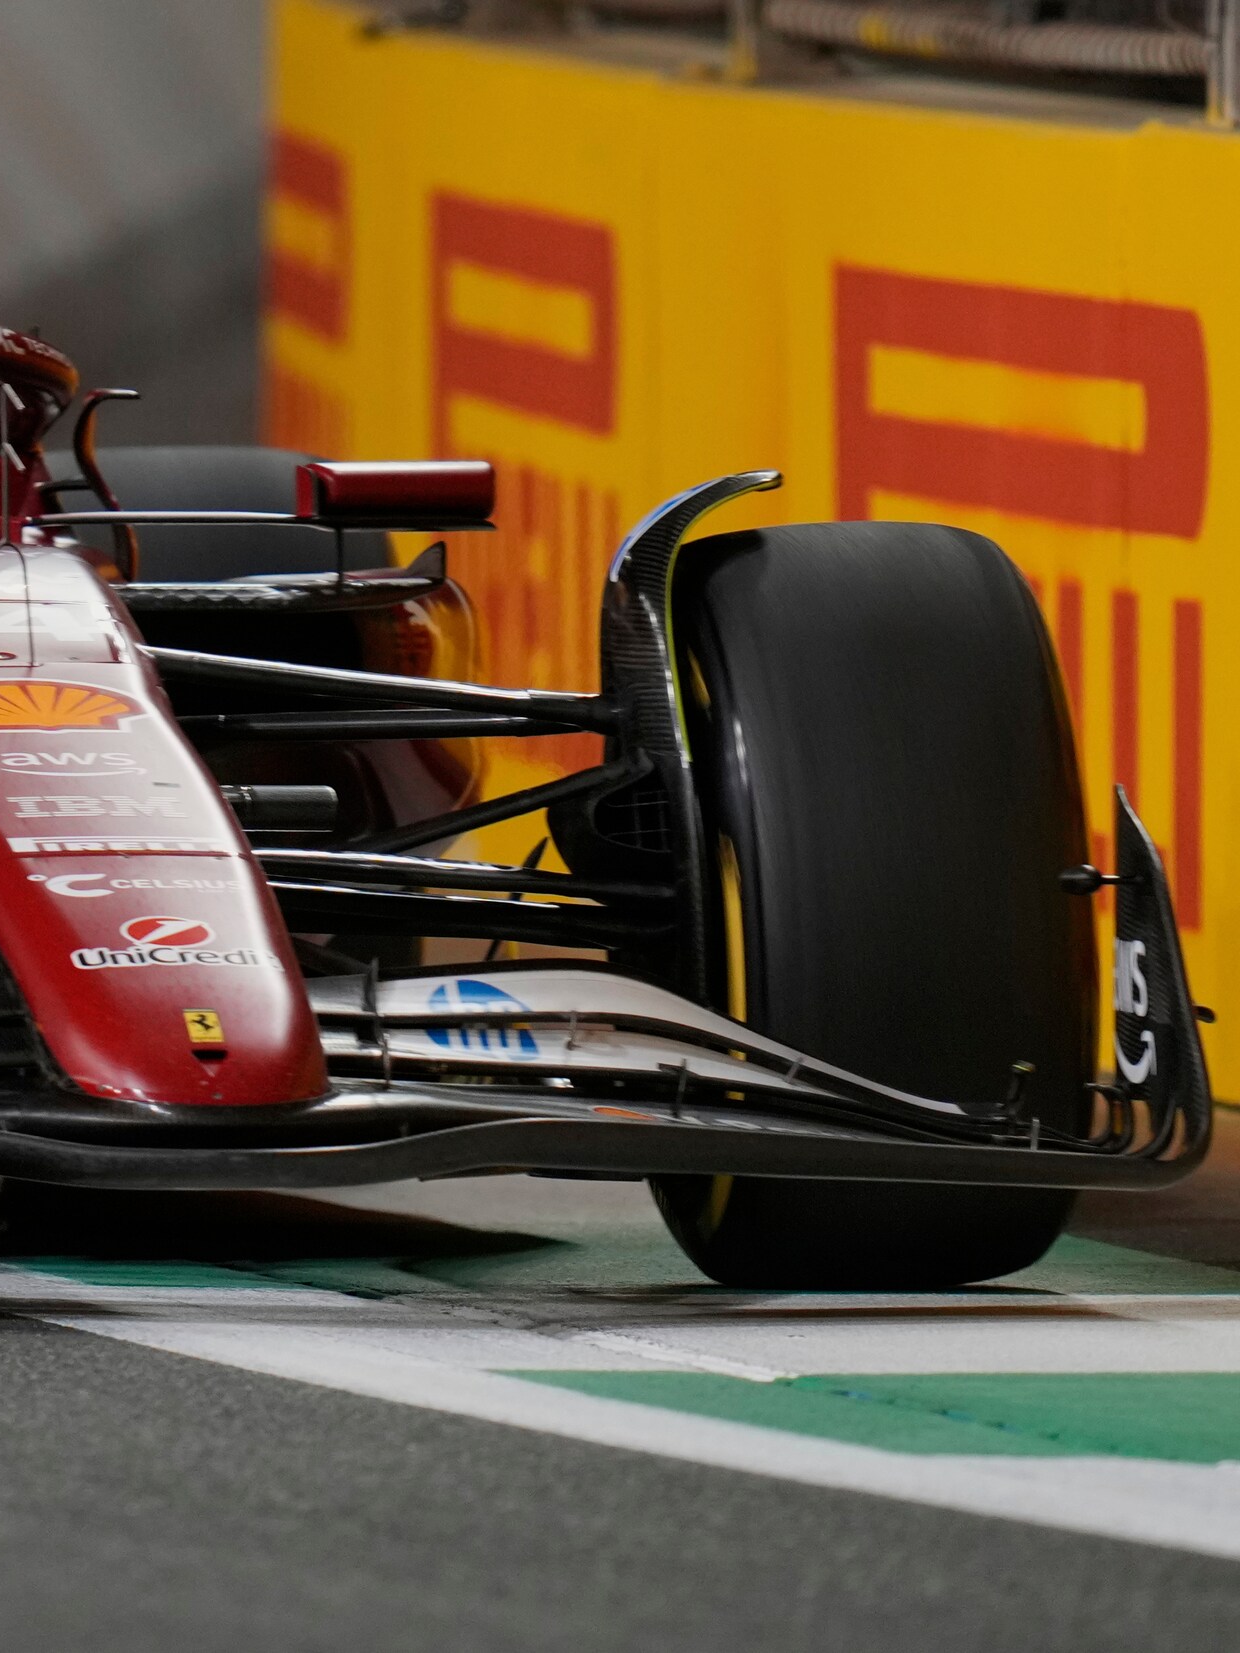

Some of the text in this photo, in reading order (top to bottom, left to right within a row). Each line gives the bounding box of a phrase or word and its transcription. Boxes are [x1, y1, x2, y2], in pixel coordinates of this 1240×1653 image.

[1, 752, 137, 767] aws
[6, 796, 189, 818] IBM
[110, 879, 244, 890] CELSIUS
